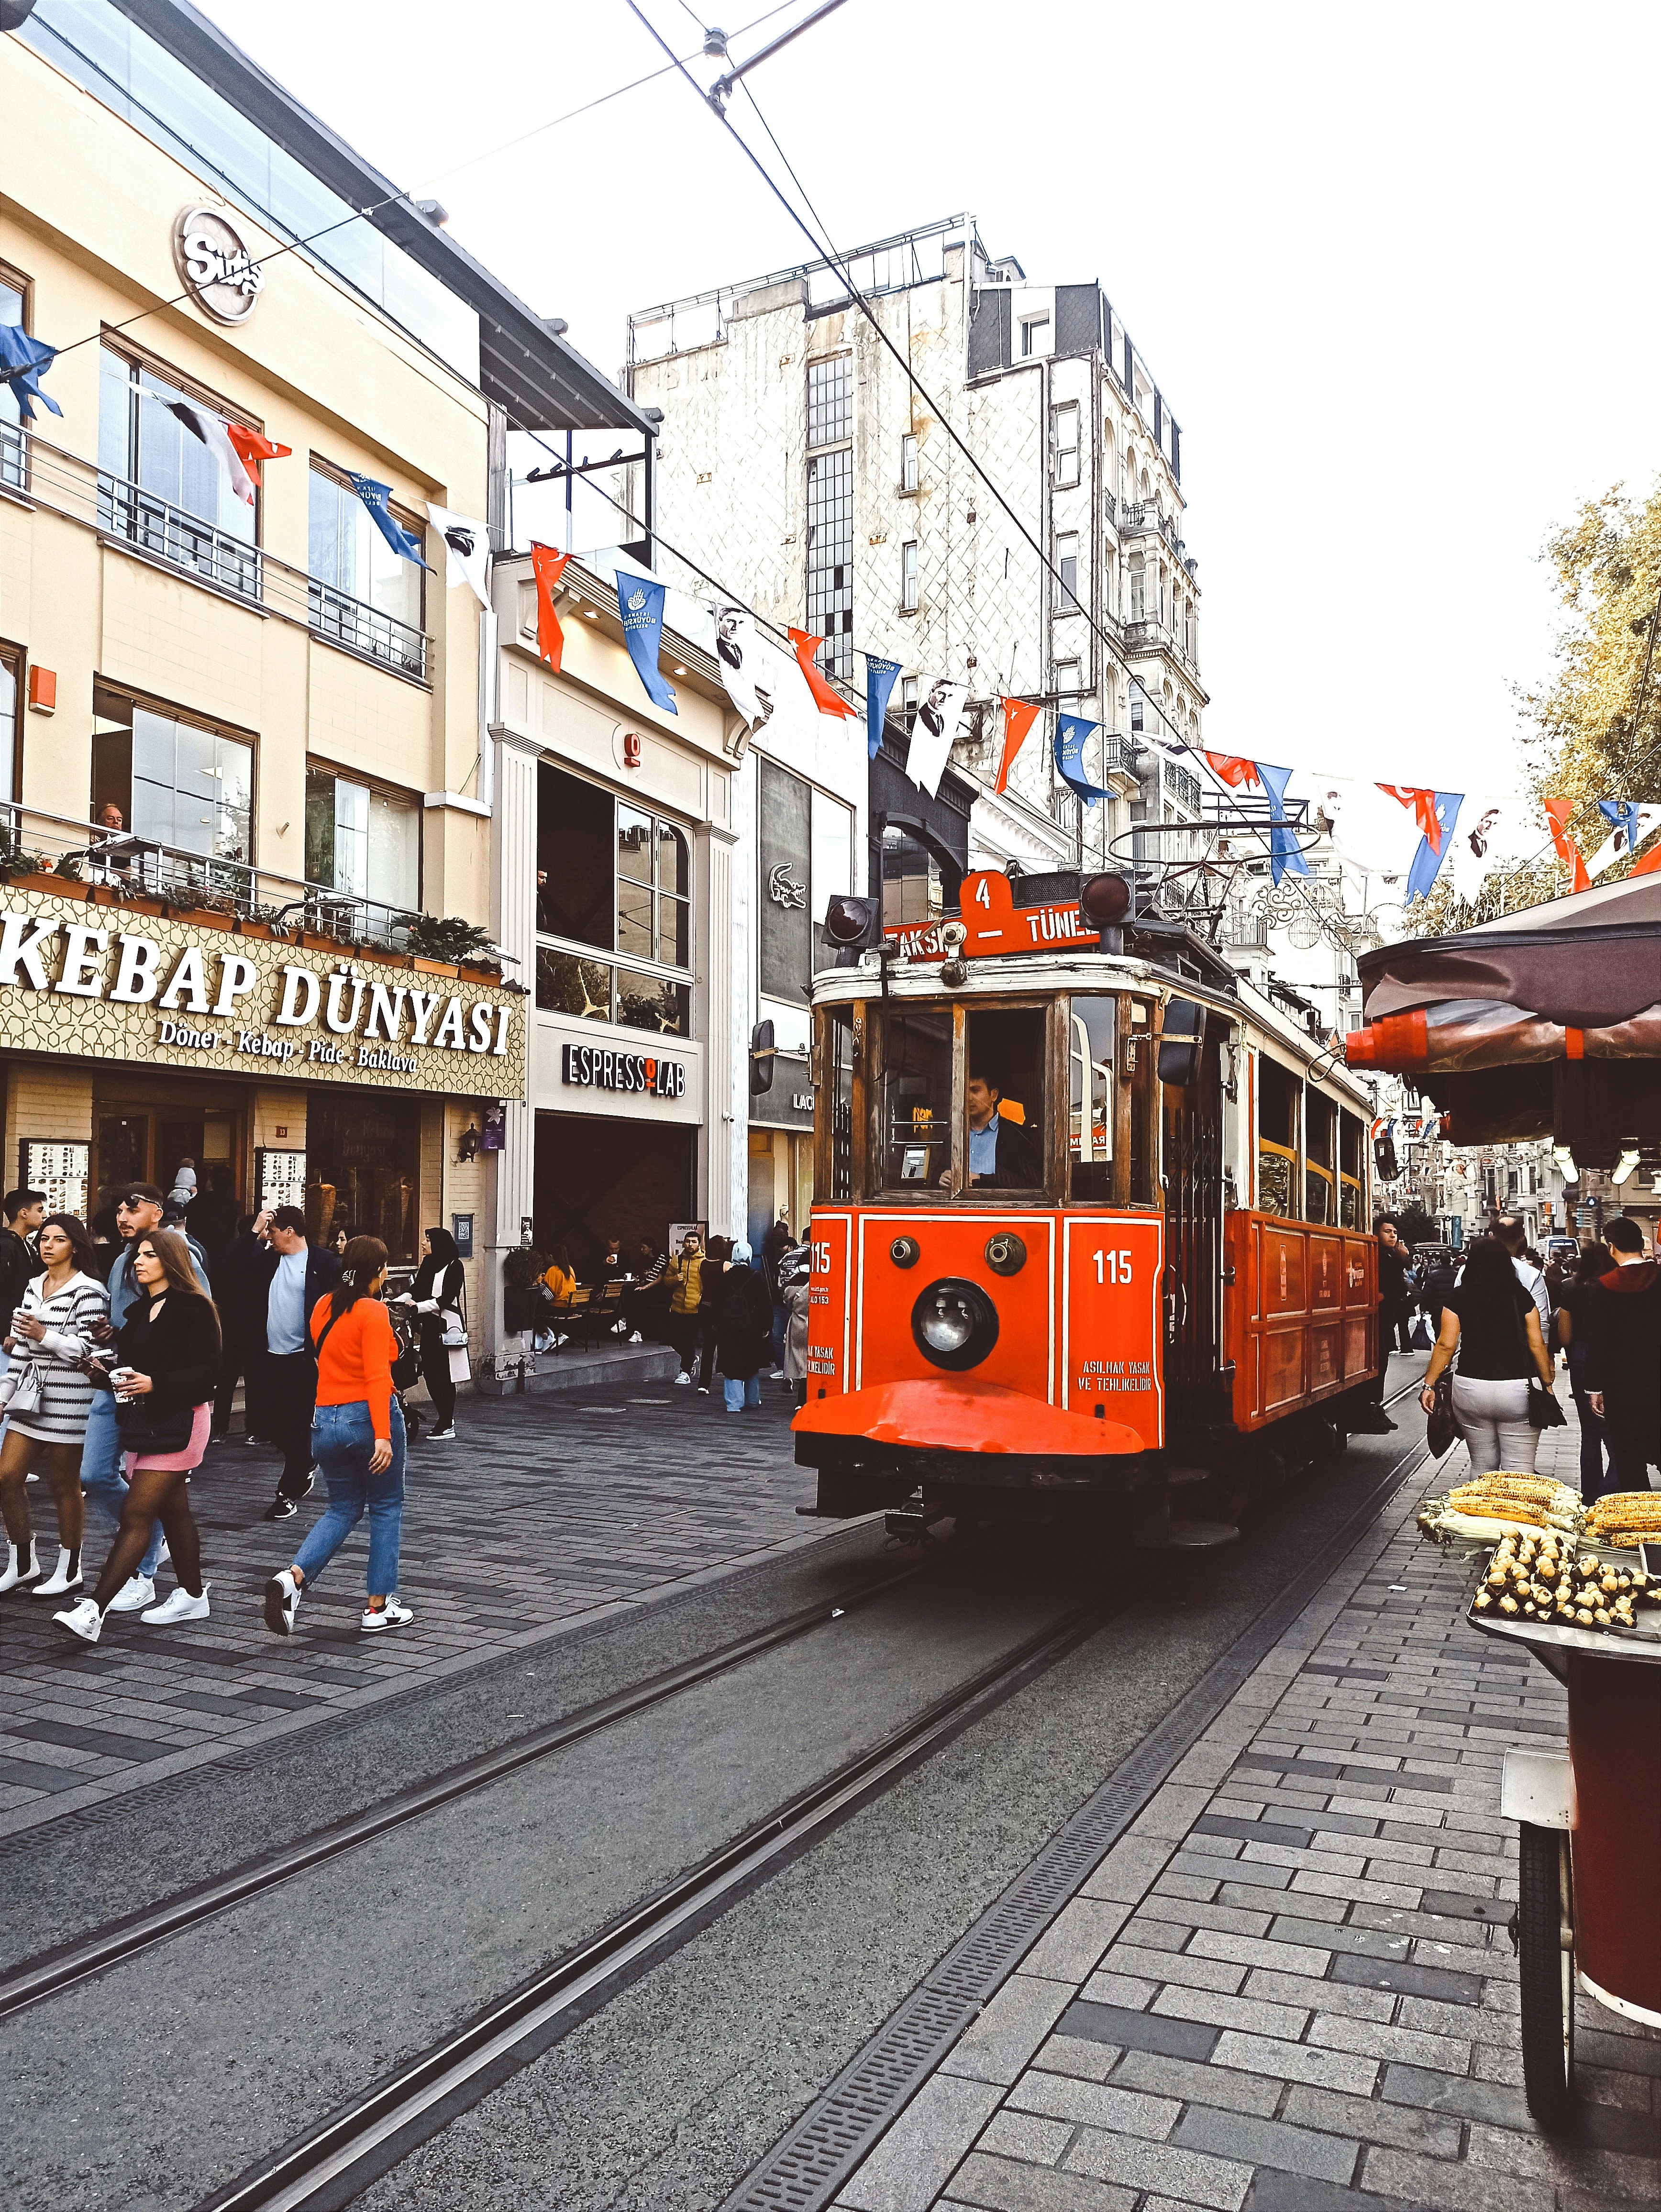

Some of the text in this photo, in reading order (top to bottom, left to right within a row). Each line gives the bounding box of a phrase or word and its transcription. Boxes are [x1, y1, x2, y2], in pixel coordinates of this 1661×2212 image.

[976, 879, 990, 909] 4
[0, 911, 512, 1056] KEBAP DÜNYASI
[158, 1020, 222, 1049] Döner
[237, 1030, 293, 1063] Kebap
[309, 1040, 343, 1064] Pide
[357, 1046, 417, 1073] Baklava
[811, 1242, 830, 1273] 115
[1093, 1250, 1132, 1284] 115
[819, 1296, 829, 1305] 153
[814, 1345, 833, 1360] YASAK
[1083, 1360, 1150, 1374] ASILMAK YASAK
[1078, 1375, 1152, 1392] VE TEHLİKELİDİR
